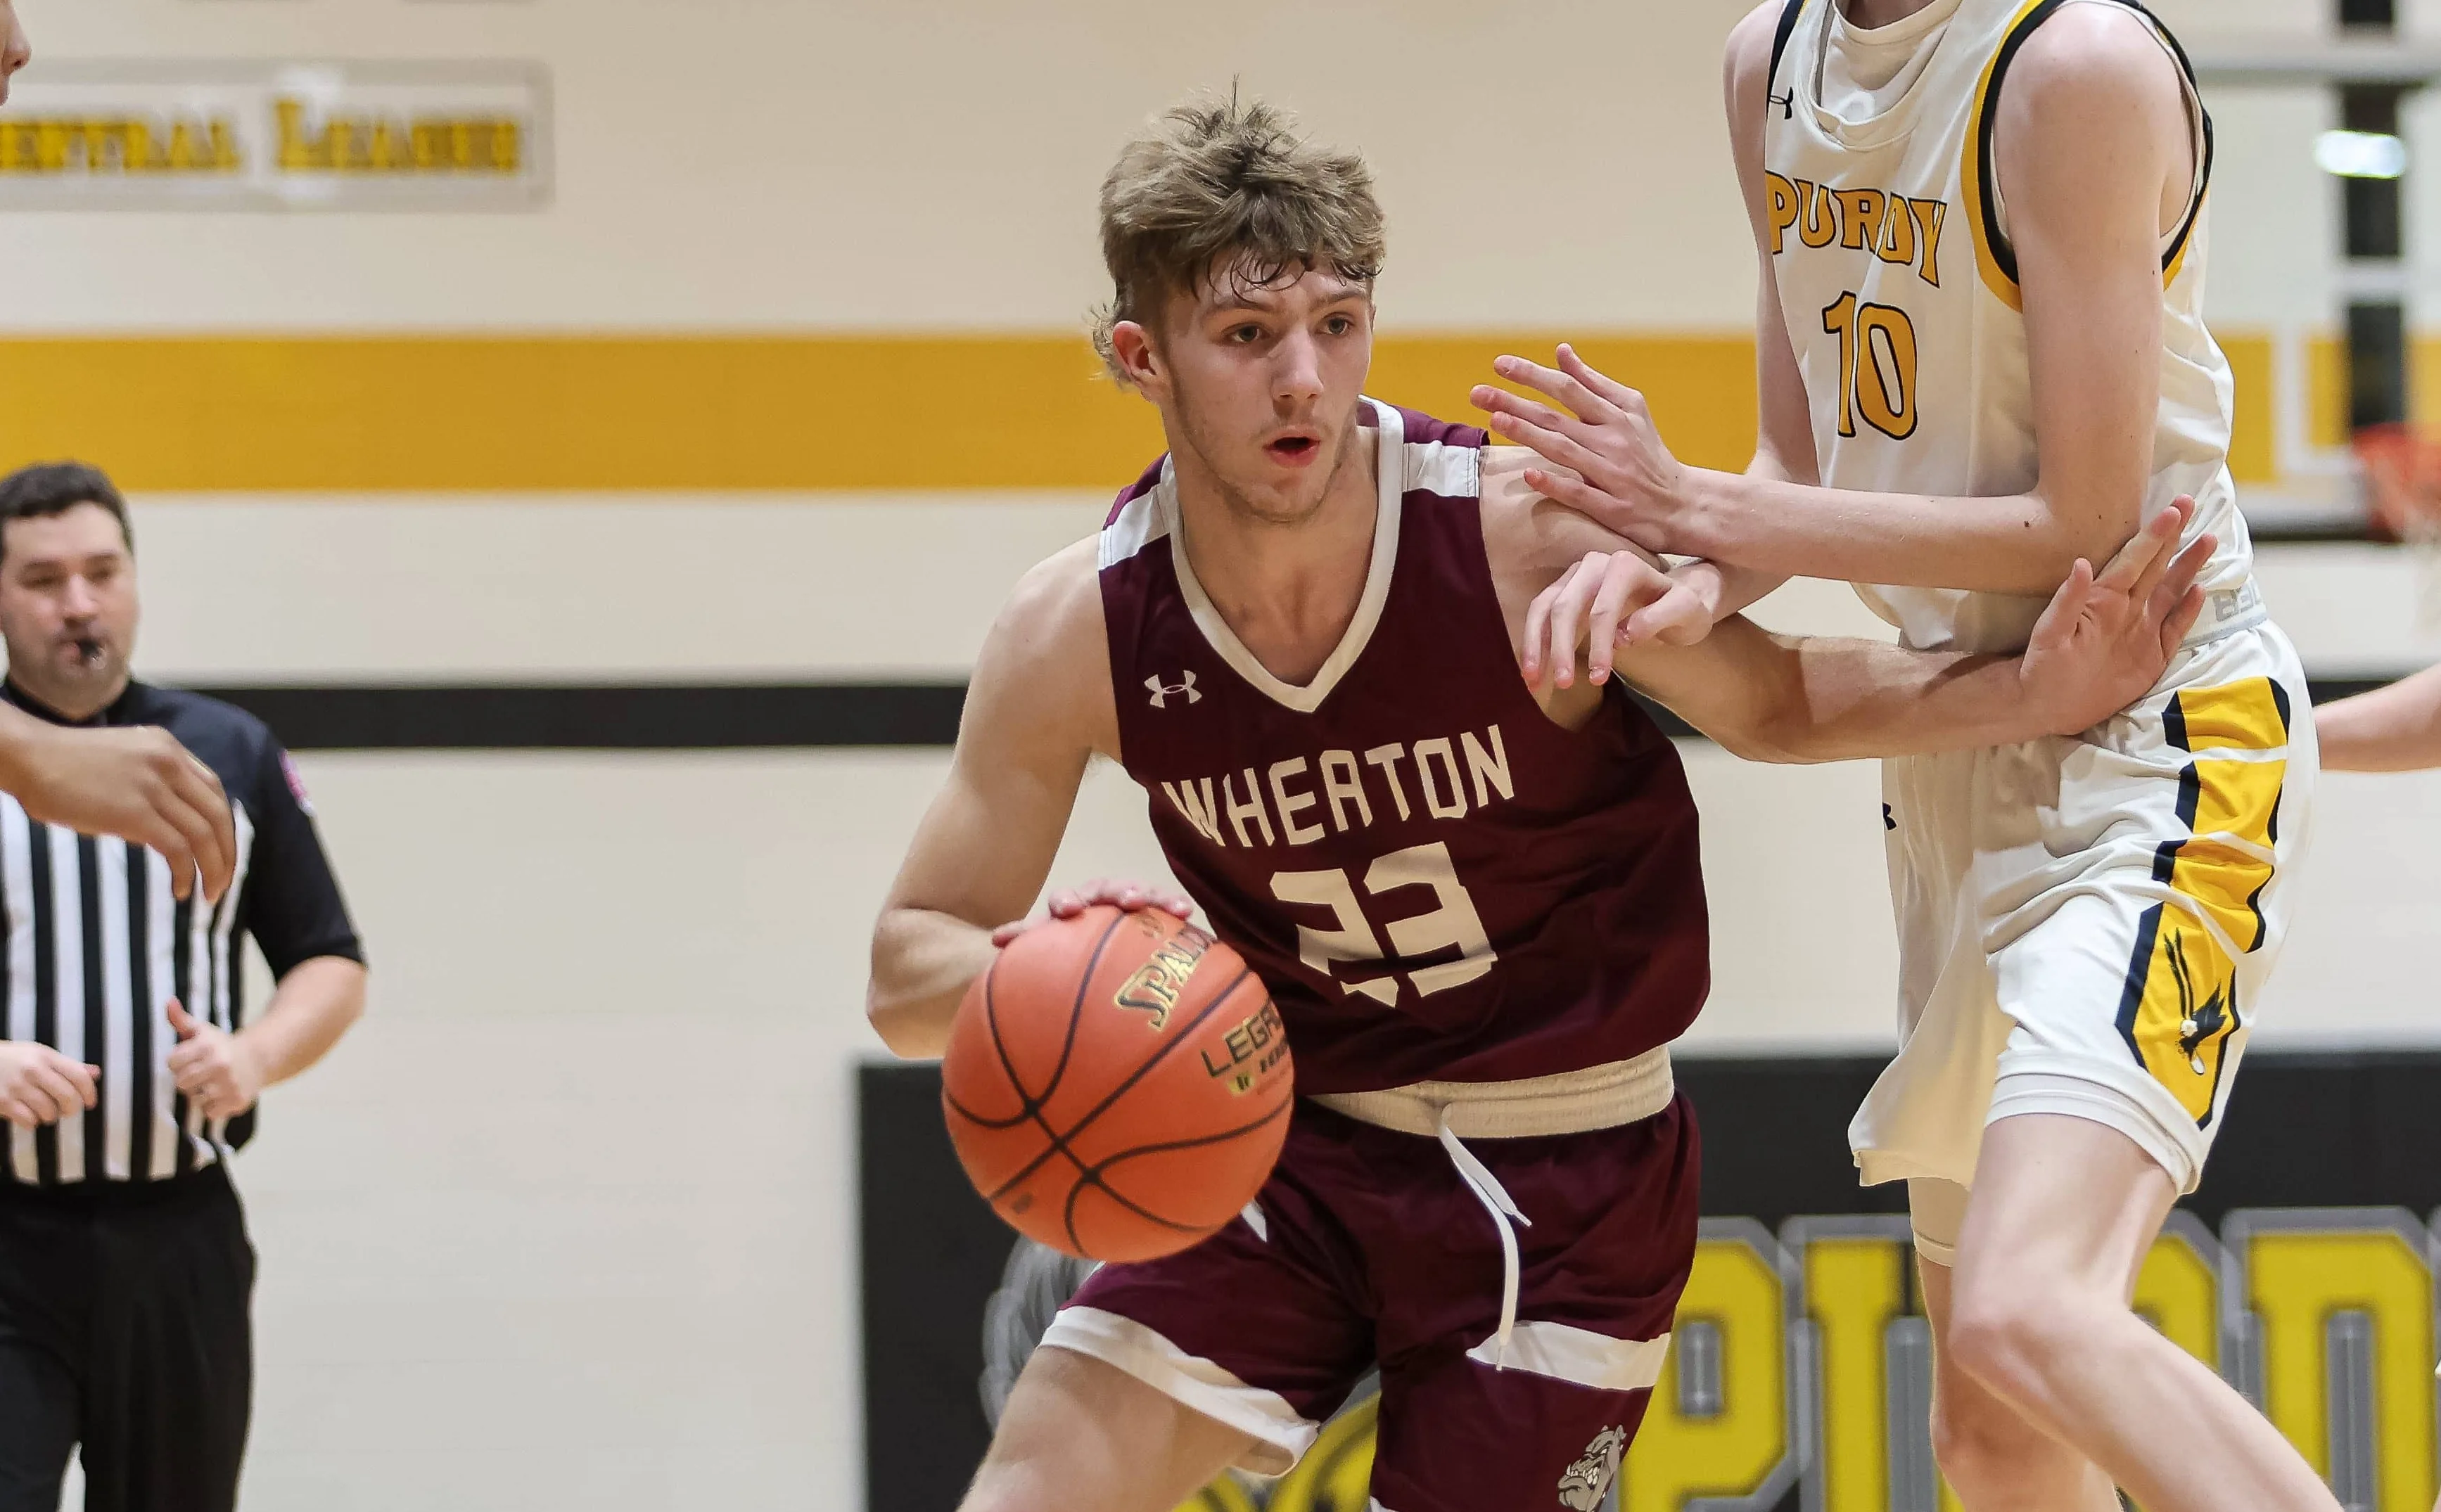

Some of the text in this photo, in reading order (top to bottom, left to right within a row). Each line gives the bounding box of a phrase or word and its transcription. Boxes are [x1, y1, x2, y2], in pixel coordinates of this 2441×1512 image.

[1764, 169, 1947, 288] PURDY
[1821, 290, 1918, 440] 10
[1161, 724, 1515, 847] WHEATON
[1269, 841, 1499, 1008] 23
